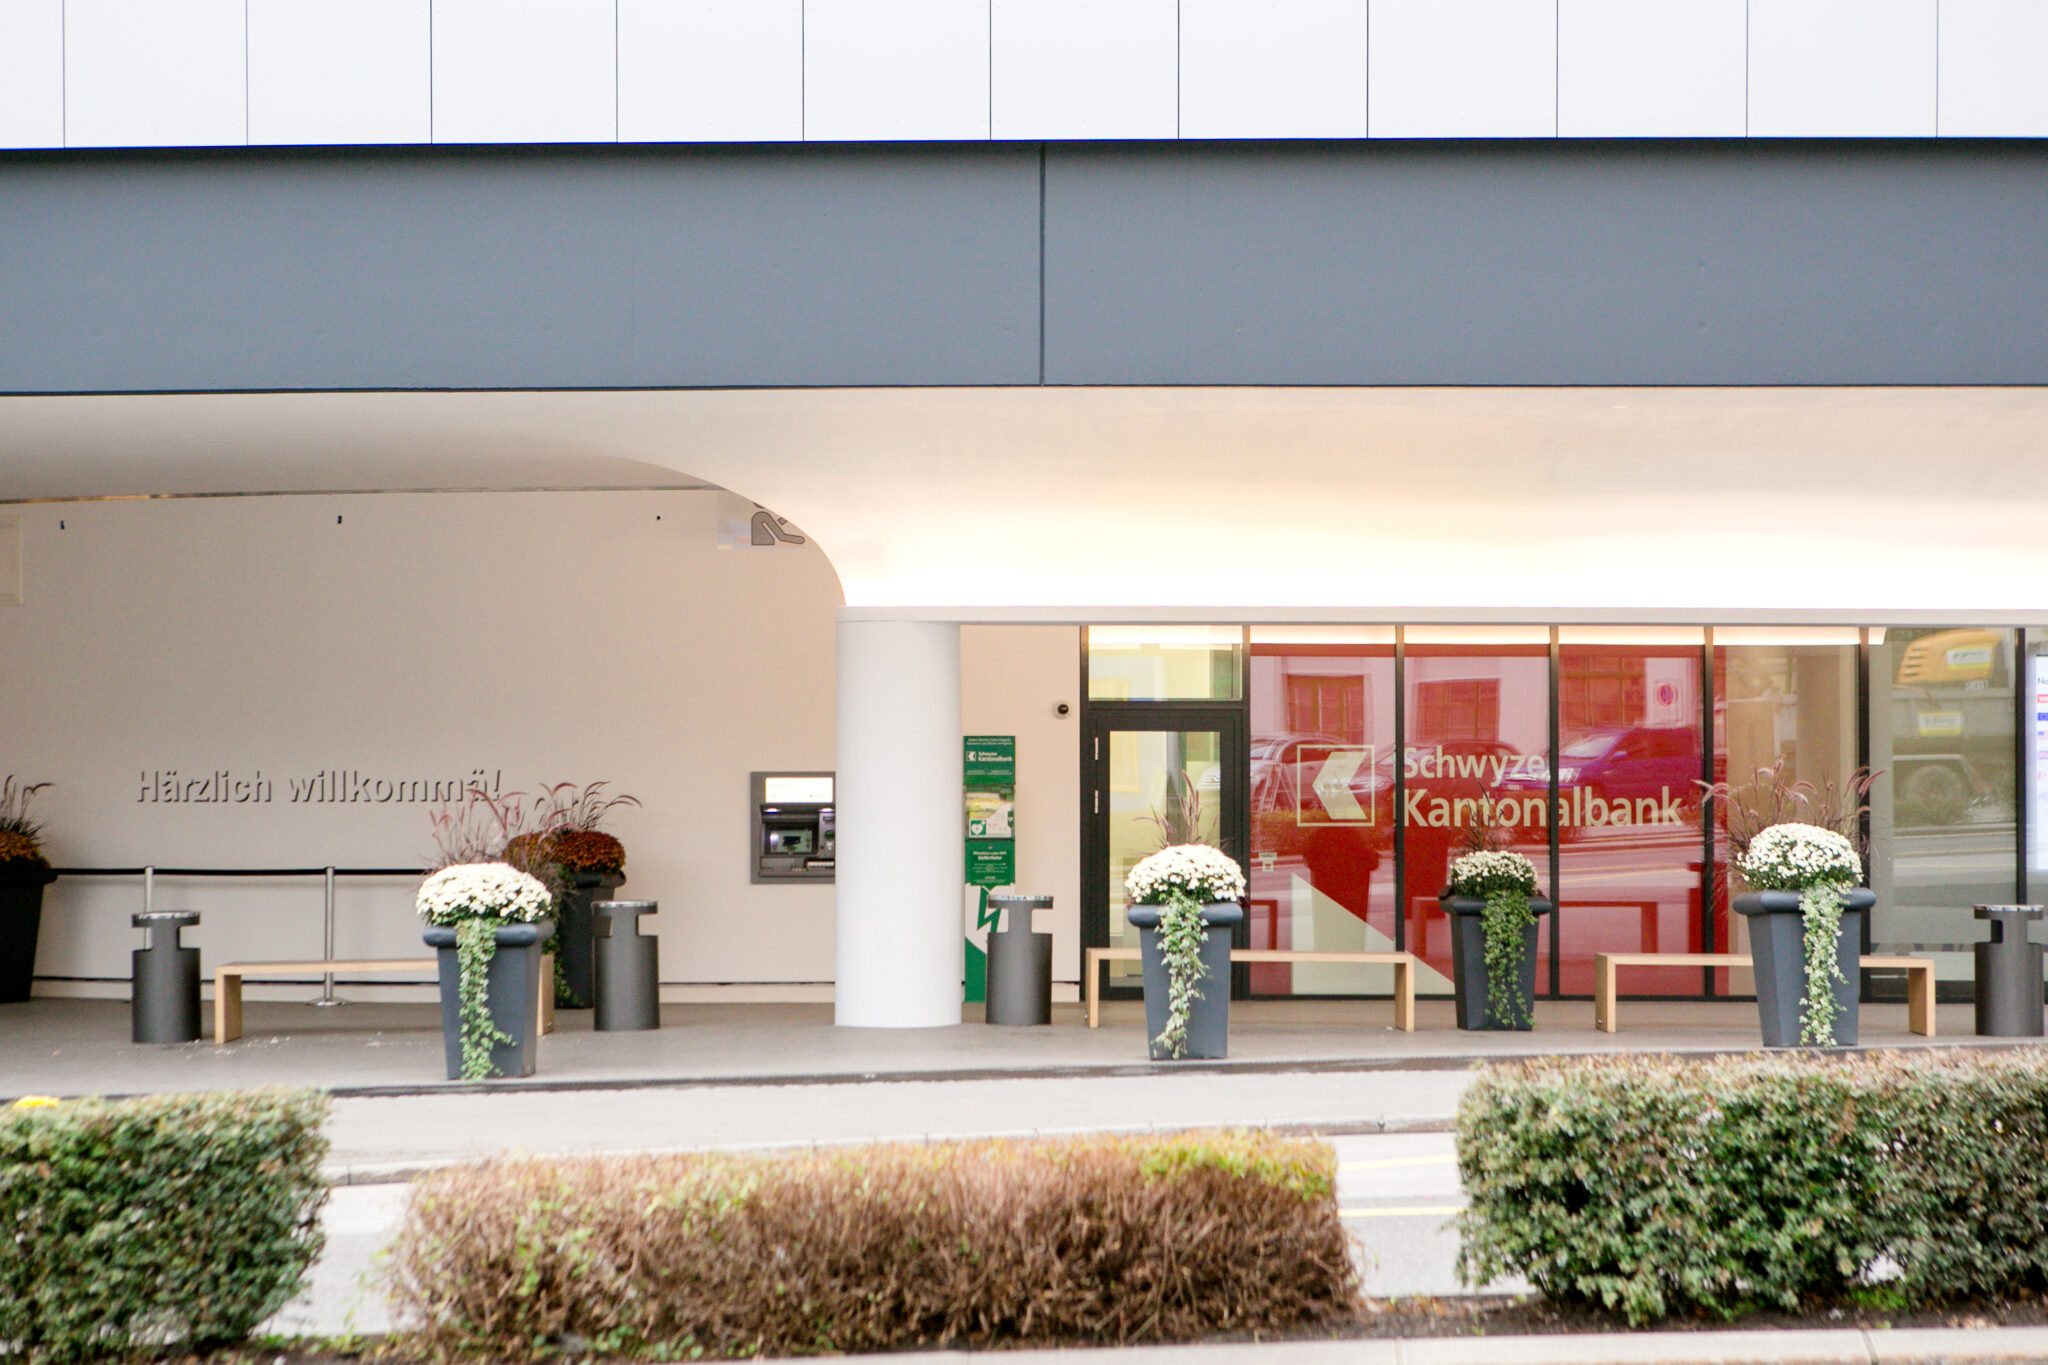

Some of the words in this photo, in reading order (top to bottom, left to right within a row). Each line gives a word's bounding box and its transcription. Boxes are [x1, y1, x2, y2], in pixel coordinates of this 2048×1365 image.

[137, 769, 272, 803] Härzlich
[290, 769, 501, 803] willkommä!
[1404, 744, 1546, 787] Schwyze
[1403, 785, 1684, 827] Kantonalbank
